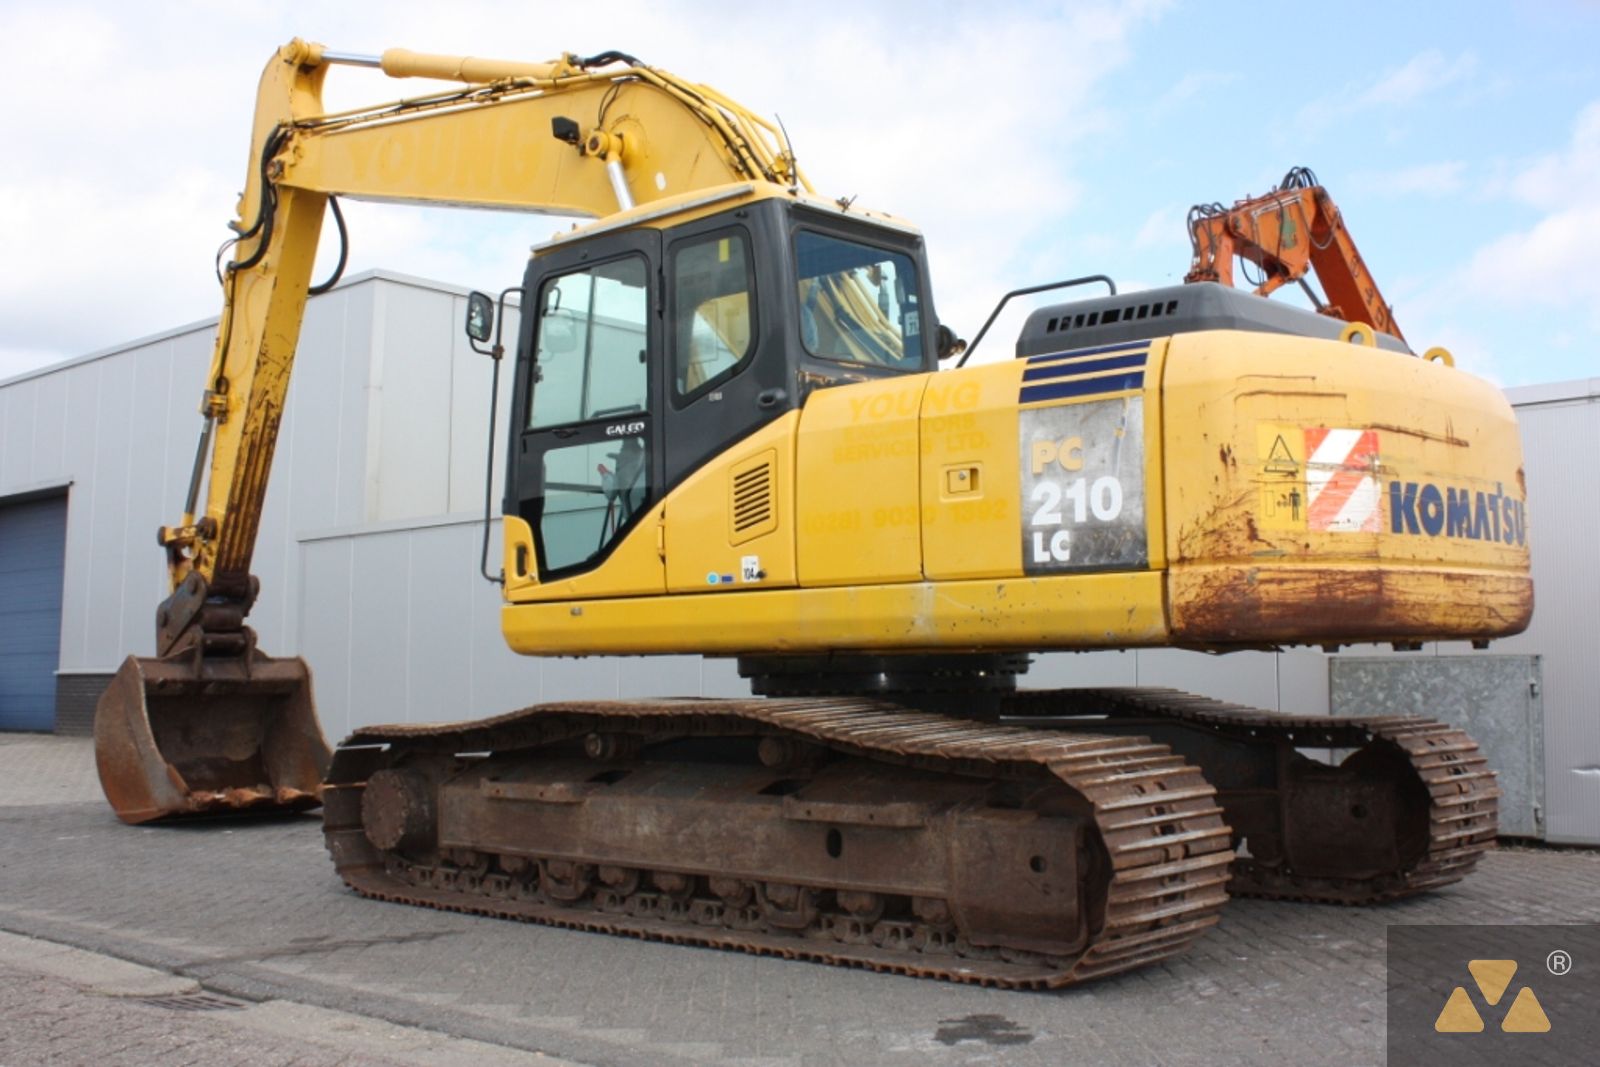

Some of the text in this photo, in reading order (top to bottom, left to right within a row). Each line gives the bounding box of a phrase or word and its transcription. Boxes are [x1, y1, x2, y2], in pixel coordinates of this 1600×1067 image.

[849, 381, 980, 422] YOUNG
[606, 421, 645, 436] GALEO
[1031, 436, 1083, 475] PC
[1031, 476, 1124, 526] 210
[1389, 480, 1527, 548] KOMATSU
[1033, 530, 1071, 563] LC
